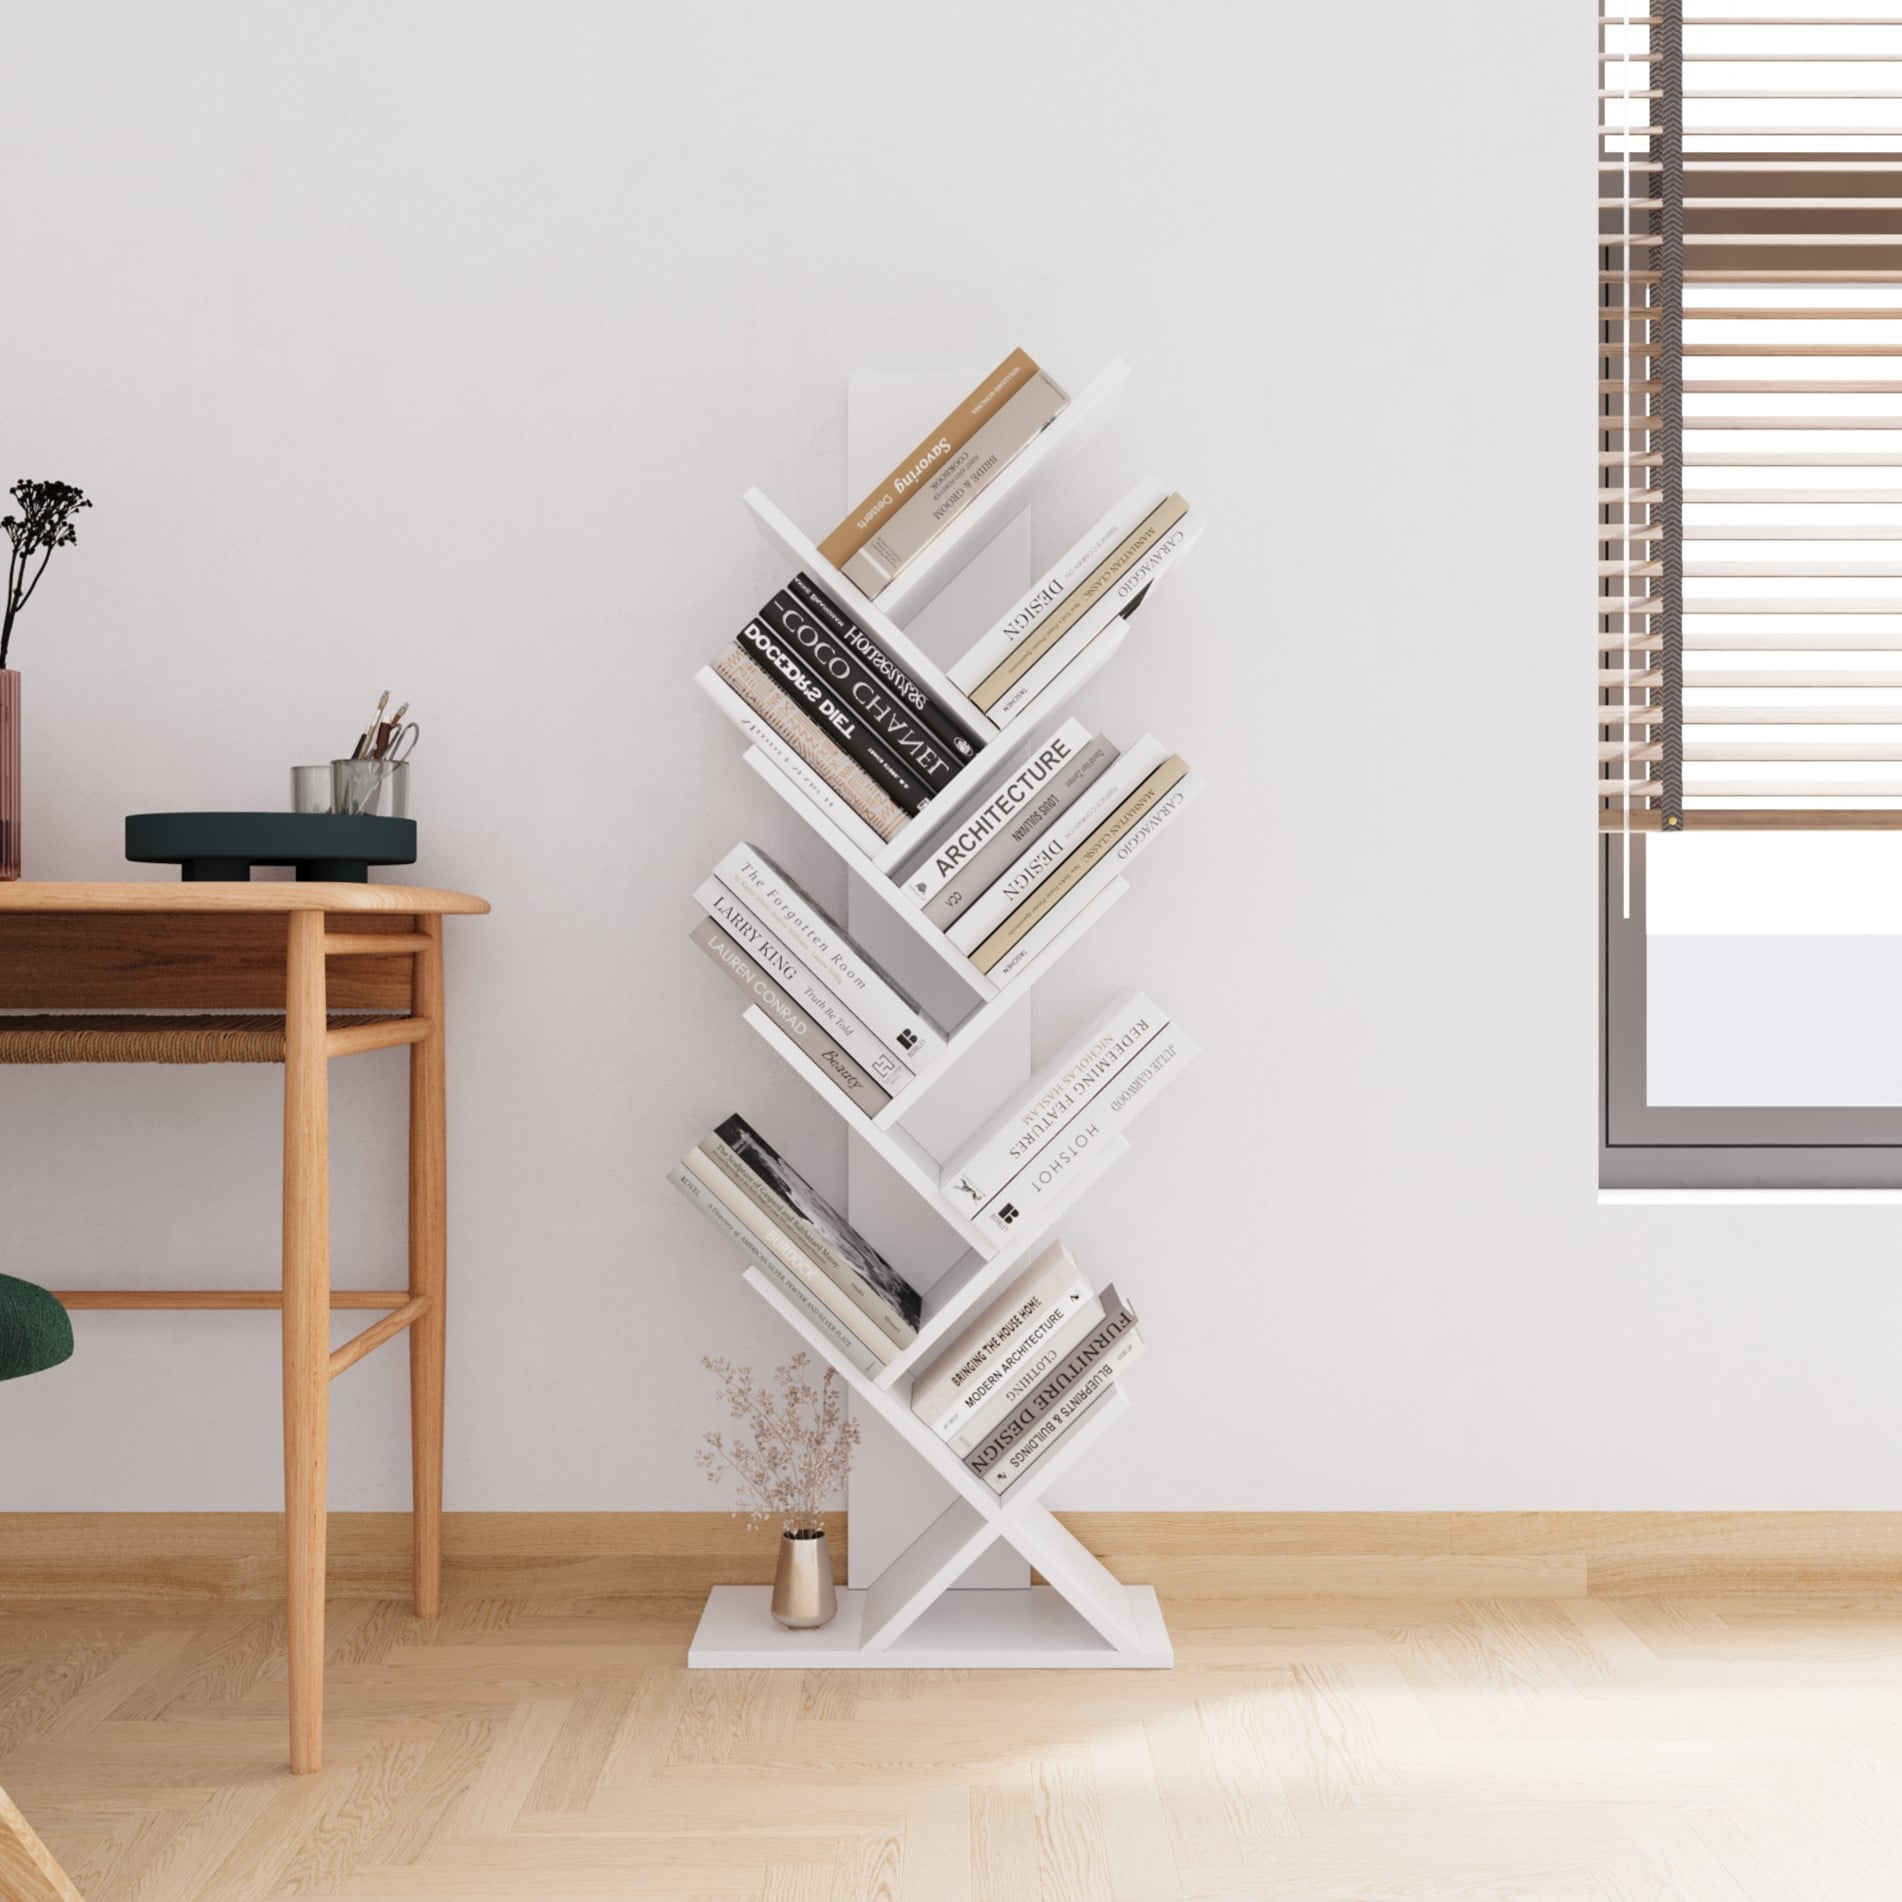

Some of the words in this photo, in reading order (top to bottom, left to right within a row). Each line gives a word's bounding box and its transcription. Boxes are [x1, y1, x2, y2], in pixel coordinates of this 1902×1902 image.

[891, 434, 953, 496] Savoring
[929, 450, 970, 491] COOKBOOK
[962, 478, 973, 490] &
[969, 453, 998, 483] BRIDE
[855, 492, 894, 531] Desserts
[931, 486, 966, 520] GROOM
[1108, 526, 1156, 574] MANHATTAN
[1115, 528, 1185, 599] CARAVAGGIO
[1000, 577, 1064, 641] DESIGN
[1001, 686, 1028, 712] TASCHEN
[931, 737, 1072, 878] ARCHITECTURE
[1010, 810, 1043, 843] SULLIVAN
[1036, 793, 1059, 816] LOUIS
[1108, 788, 1156, 836] MANHATTAN
[1114, 790, 1185, 861] CARAVAGGIO
[1001, 838, 1064, 902] DESIGN
[739, 861, 767, 889] The
[763, 887, 831, 955] Forgotten
[829, 951, 869, 990] Room
[944, 890, 963, 909] CCA
[712, 895, 762, 945] LARRY
[757, 940, 799, 981] KING
[1001, 949, 1027, 975] TASCHEN
[707, 934, 757, 984] LAUREN
[751, 978, 809, 1037] CONRAD
[803, 986, 828, 1010] Truth
[823, 1005, 838, 1021] Be
[834, 1016, 855, 1037] Told
[819, 1046, 867, 1095] Beauty
[1060, 1033, 1114, 1086] NICHOLAS
[1071, 1018, 1149, 1096] REDEEMING
[1147, 1043, 1178, 1074] JULIE
[1020, 1083, 1064, 1126] HASLAM
[1108, 1067, 1154, 1113] GARWOOD
[1007, 1093, 1074, 1160] FEATURES
[1029, 1122, 1099, 1194] HOTSHOT
[765, 1228, 817, 1281] BURDOCK
[950, 1350, 987, 1387] BRINGING
[982, 1336, 1001, 1355] THE
[995, 1315, 1022, 1342] HOUSE
[1017, 1295, 1042, 1320] HOME
[964, 1369, 1003, 1408] MODERN
[999, 1308, 1064, 1373] ARCHITECTURE
[1031, 1311, 1132, 1411] FURNITURE
[1004, 1348, 1058, 1402] CLOTHING
[1059, 1363, 1113, 1417] BLUEPRINTS
[969, 1406, 1036, 1473] DESIGN
[1008, 1420, 1056, 1468] BUILDINGS
[1052, 1413, 1064, 1425] &
